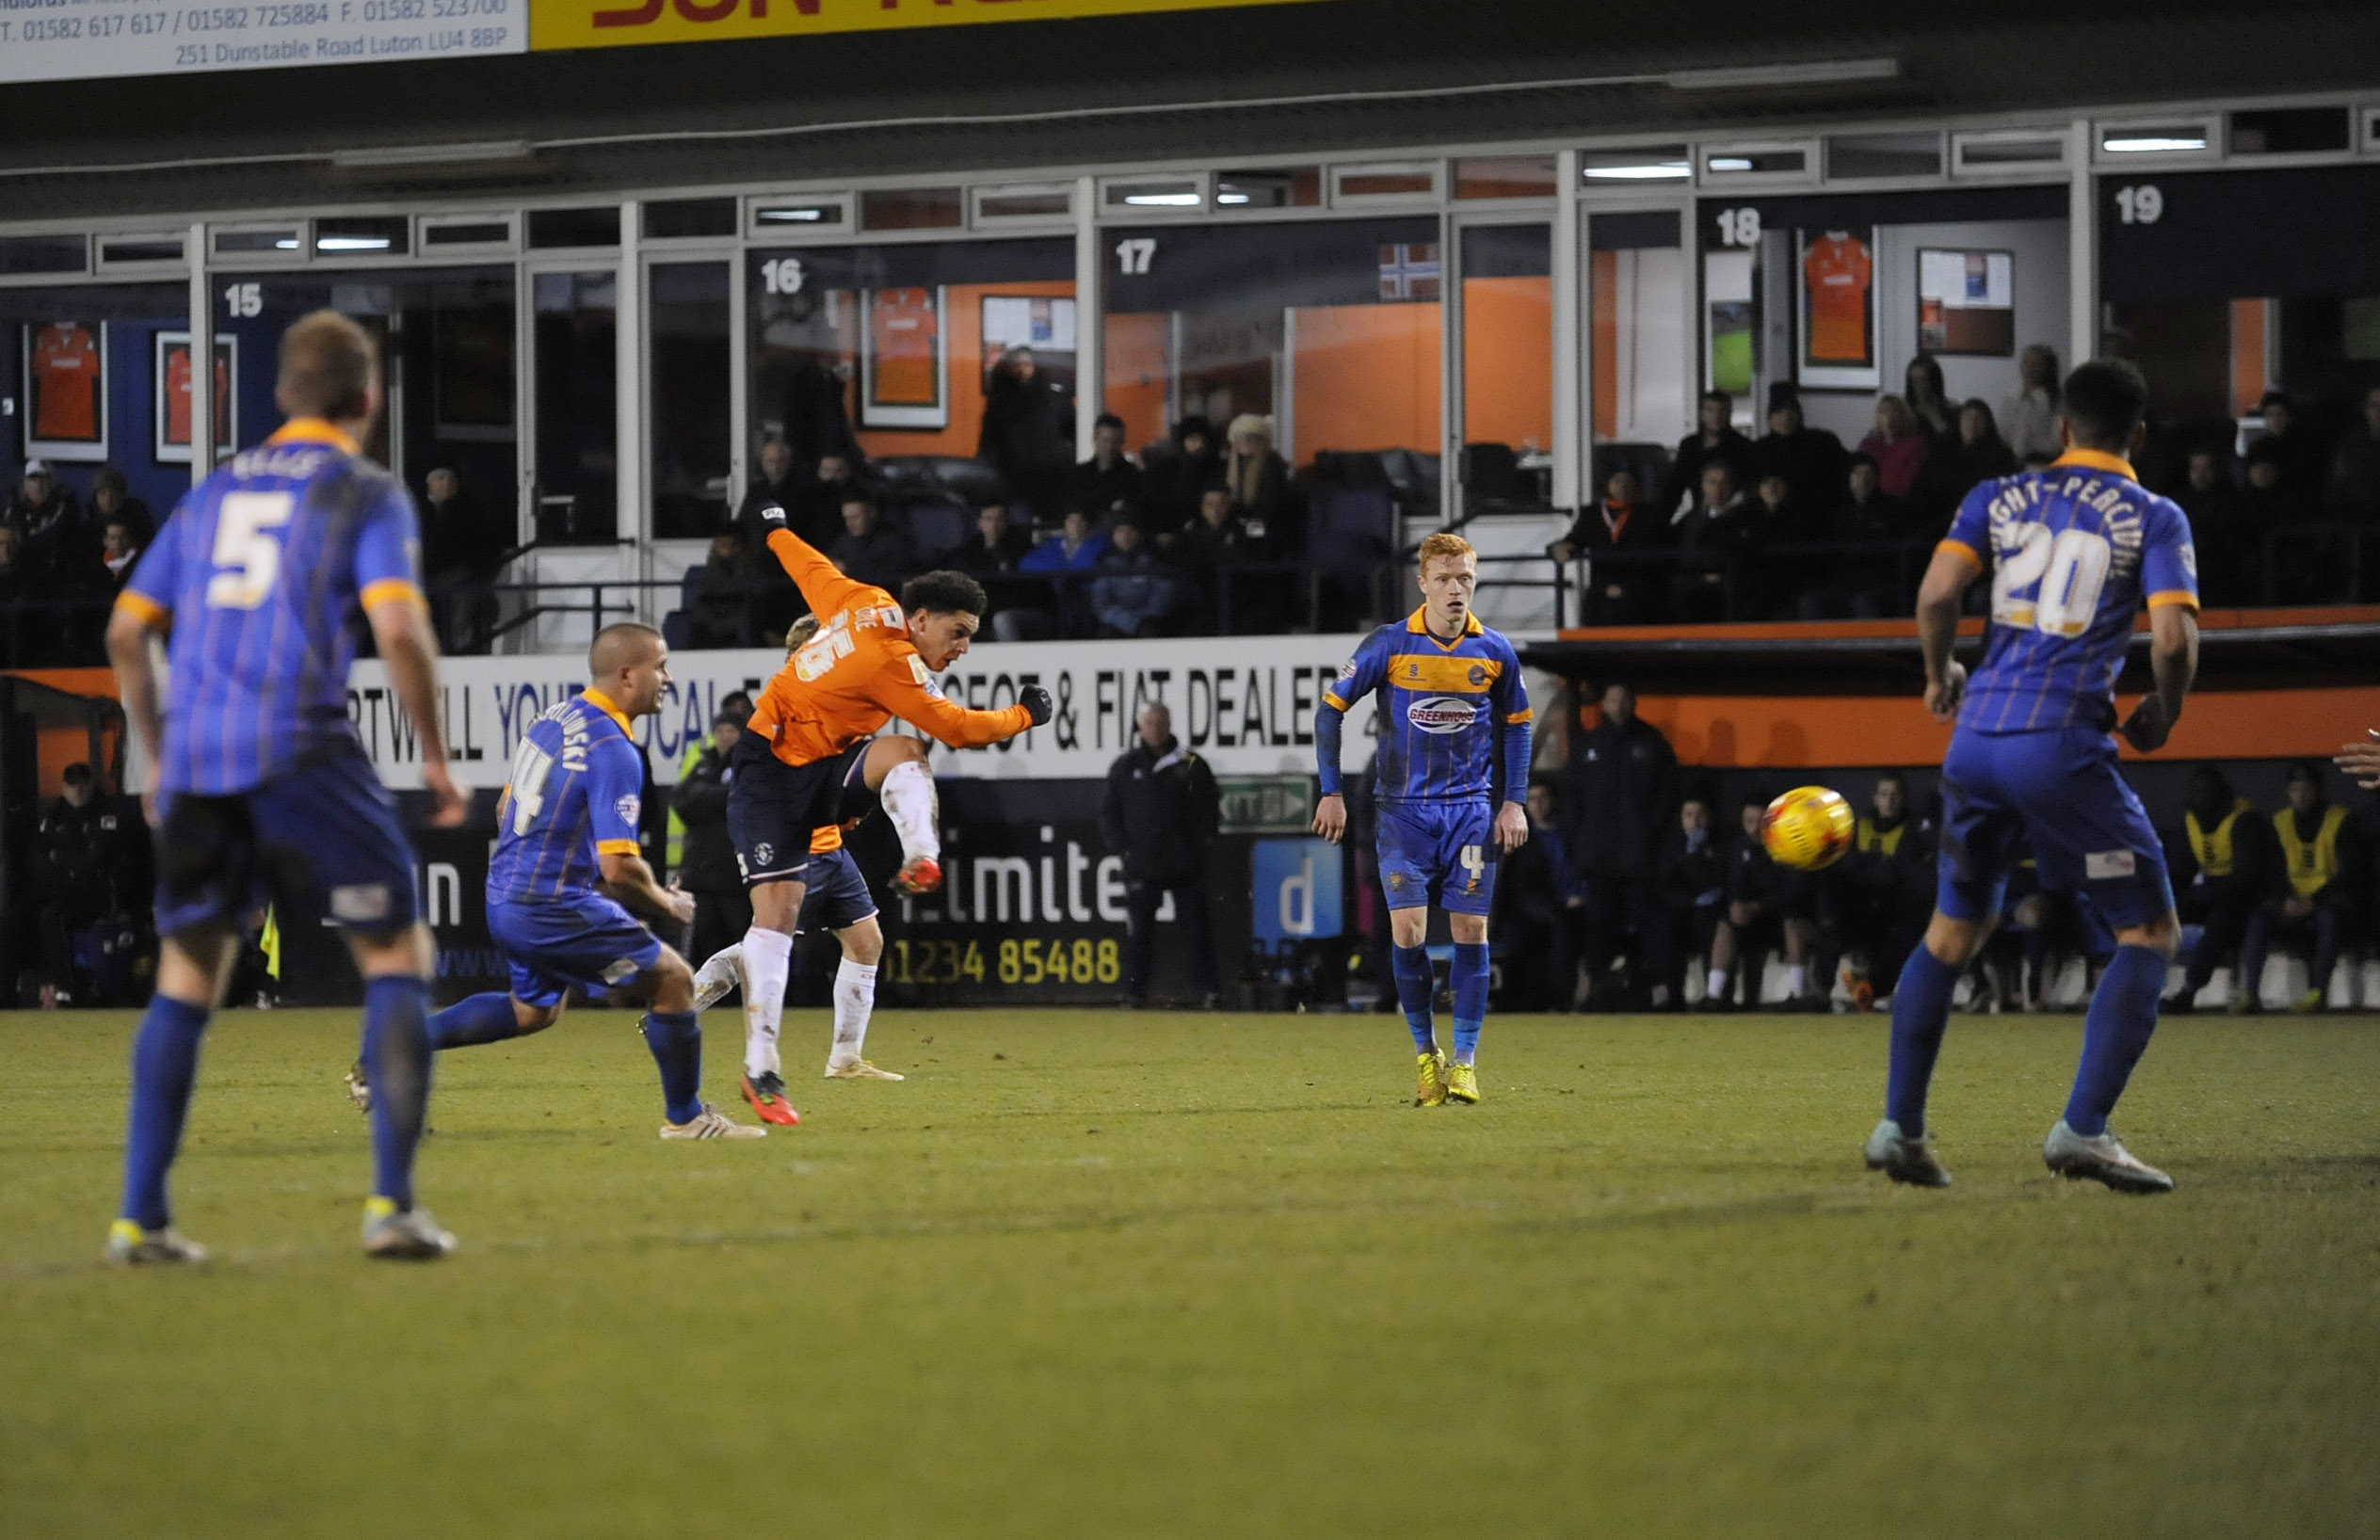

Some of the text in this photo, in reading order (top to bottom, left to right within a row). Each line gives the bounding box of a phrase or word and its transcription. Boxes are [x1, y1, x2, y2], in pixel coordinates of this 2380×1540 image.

[23, 17, 81, 42] 01582
[88, 14, 124, 38] 617
[130, 11, 167, 36] 617
[187, 7, 248, 31] 01582
[256, 3, 329, 26] 725884
[363, 0, 426, 22] 01582
[176, 26, 507, 65] 251 Dunstable Road Luton LU4 8BP
[2115, 185, 2163, 224] 19
[1716, 207, 1761, 245] 18
[1116, 238, 1157, 274] 17
[761, 259, 801, 293] 16
[225, 283, 263, 317] 15
[205, 490, 294, 610] 5
[1990, 521, 2112, 638] 20
[1054, 671, 1081, 750] &
[901, 826, 1176, 922] imite
[1460, 845, 1485, 879] 4
[885, 938, 1120, 984] 1234 85488
